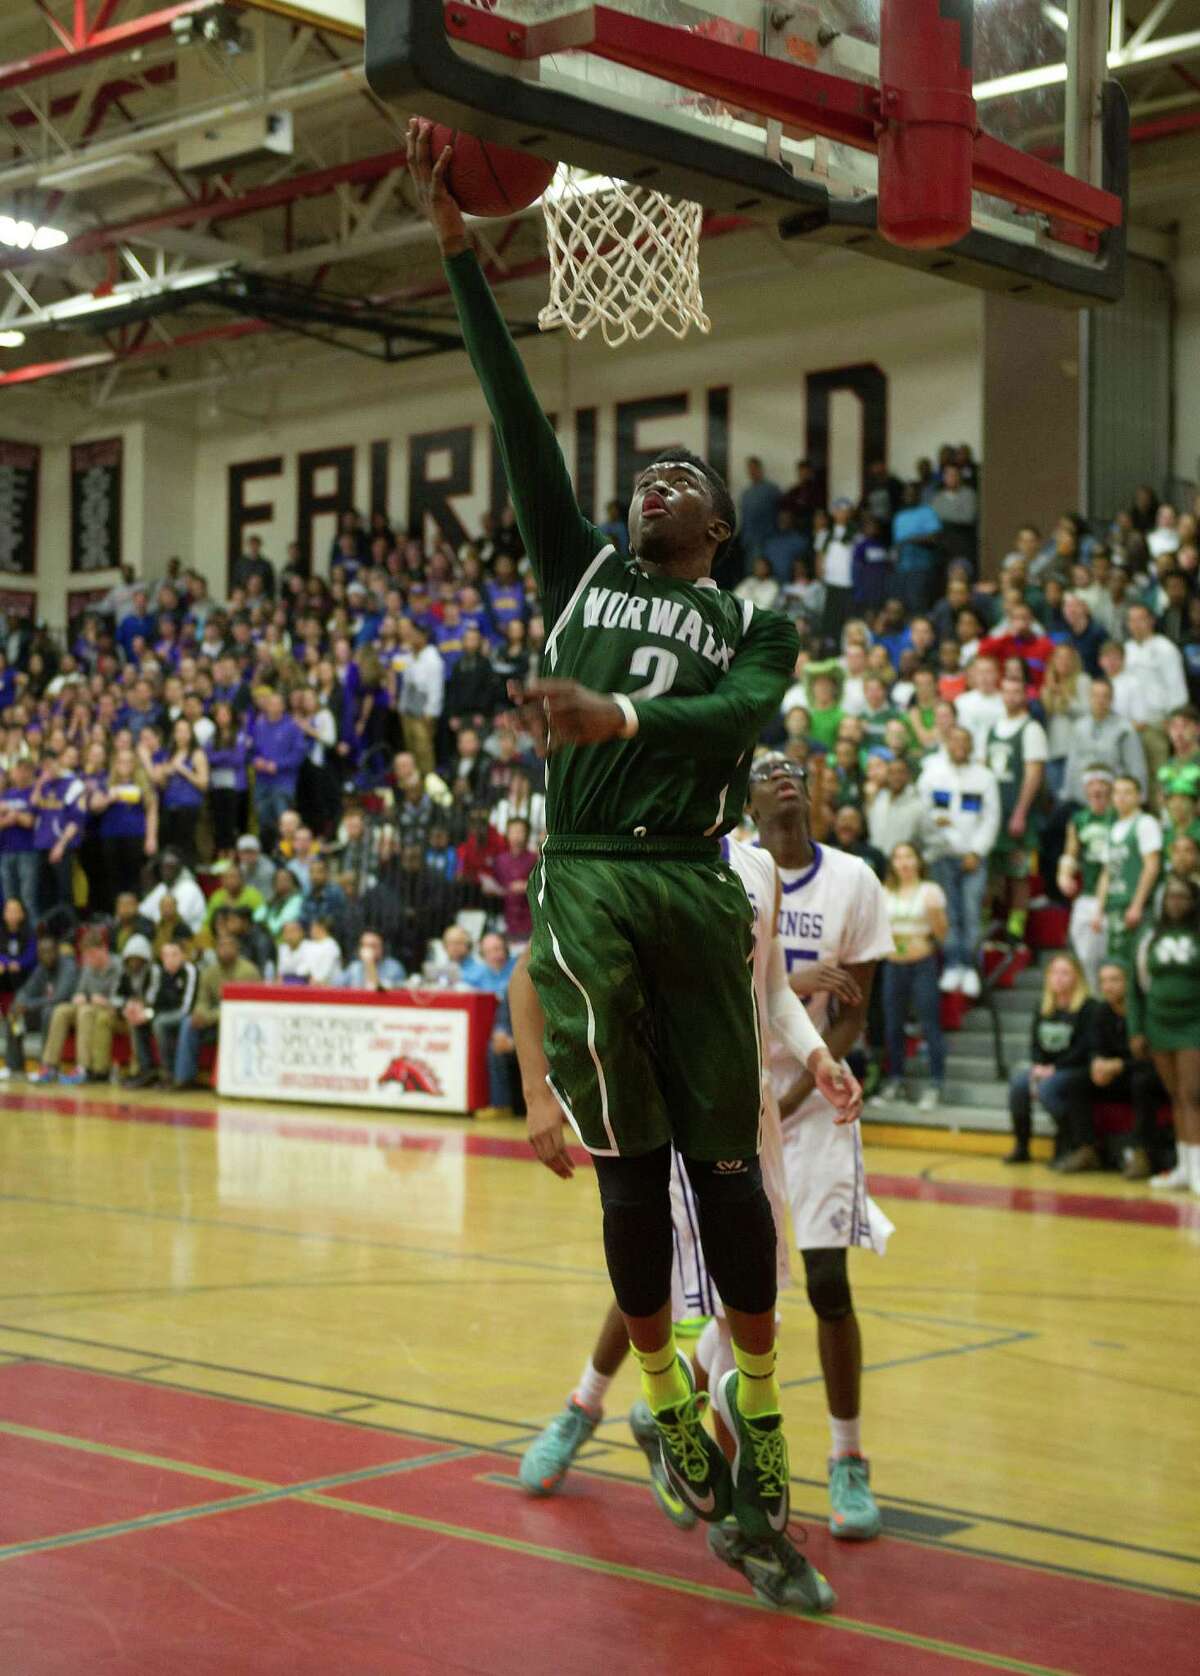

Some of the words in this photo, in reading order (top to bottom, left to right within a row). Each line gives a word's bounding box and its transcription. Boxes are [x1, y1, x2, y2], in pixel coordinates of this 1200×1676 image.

[228, 362, 889, 588] FAIRIED
[628, 645, 679, 701] 2
[776, 911, 823, 939] INGS
